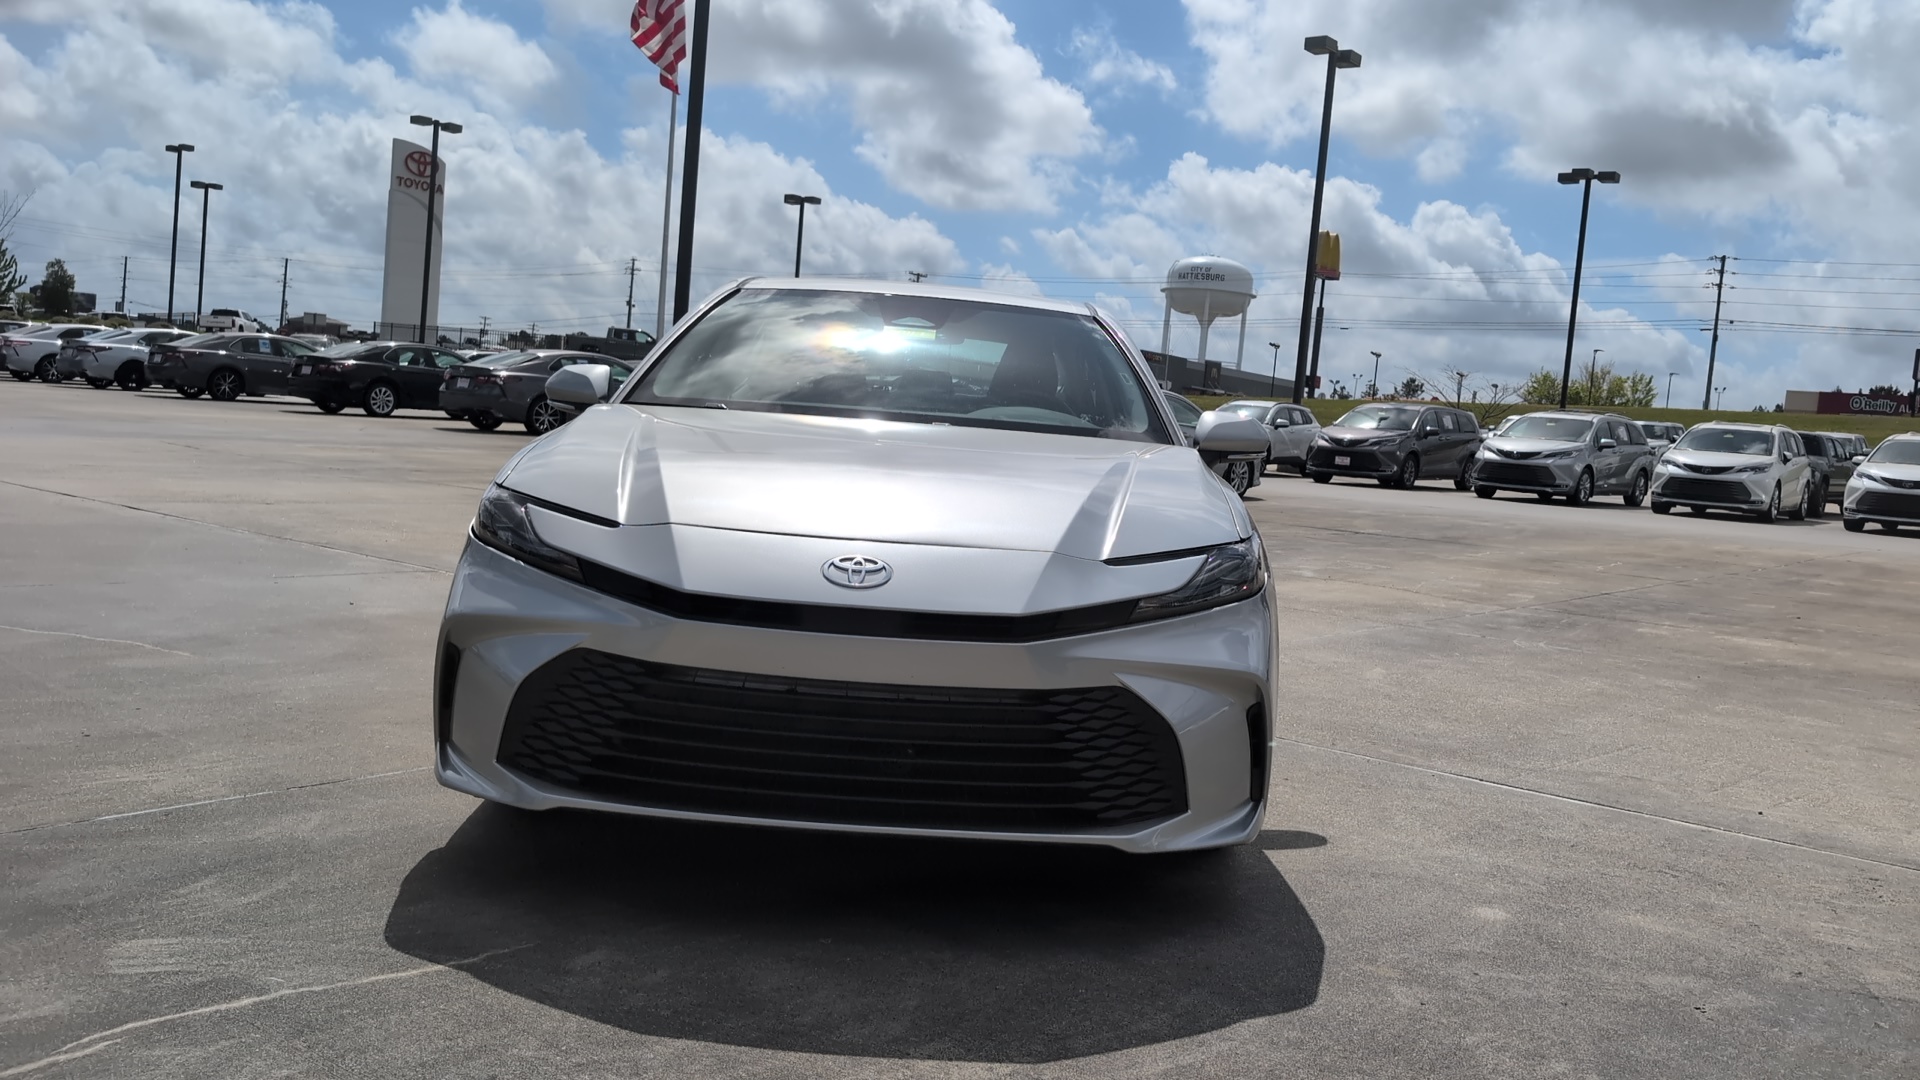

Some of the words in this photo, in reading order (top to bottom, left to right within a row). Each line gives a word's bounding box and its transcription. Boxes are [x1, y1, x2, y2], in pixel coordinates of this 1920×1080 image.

[396, 176, 444, 195] TOYOA
[1178, 272, 1226, 282] HATTIESBURG
[1850, 396, 1897, 413] O'Reilly
